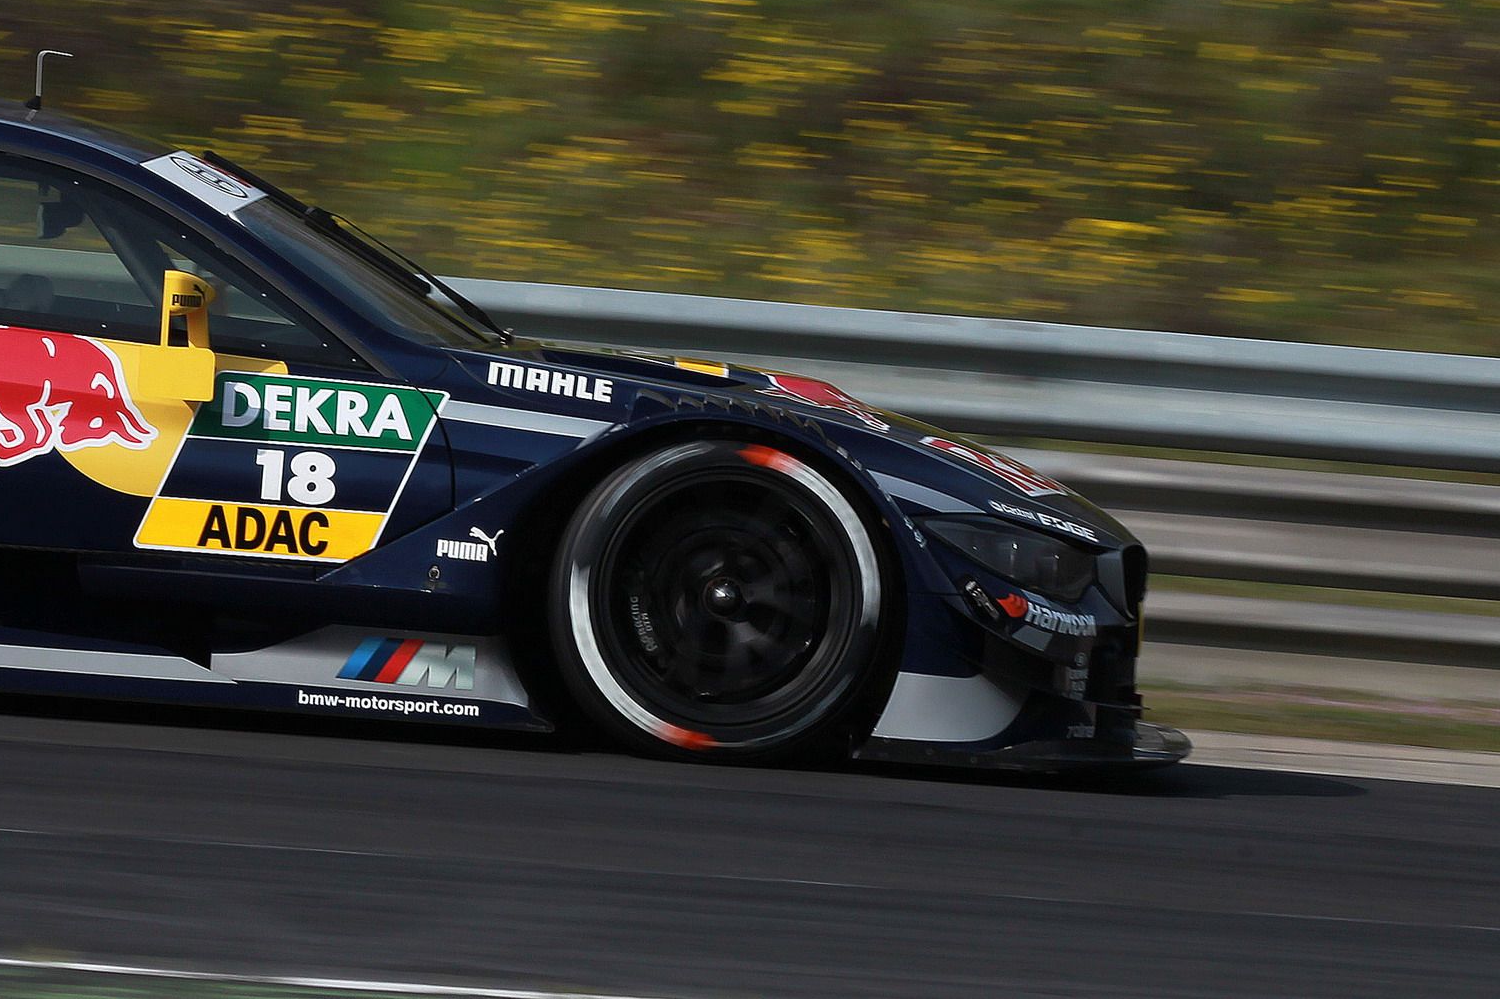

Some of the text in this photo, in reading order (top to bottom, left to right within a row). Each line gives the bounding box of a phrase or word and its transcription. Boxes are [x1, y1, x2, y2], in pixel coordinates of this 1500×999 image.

[487, 361, 614, 404] MAHLE
[221, 381, 413, 441] DEKRA
[256, 448, 337, 506] 18
[197, 505, 330, 556] ADAC
[1037, 512, 1101, 543] EDGE
[436, 539, 489, 562] PUMA
[298, 690, 480, 716] bmw-motorsport.com
